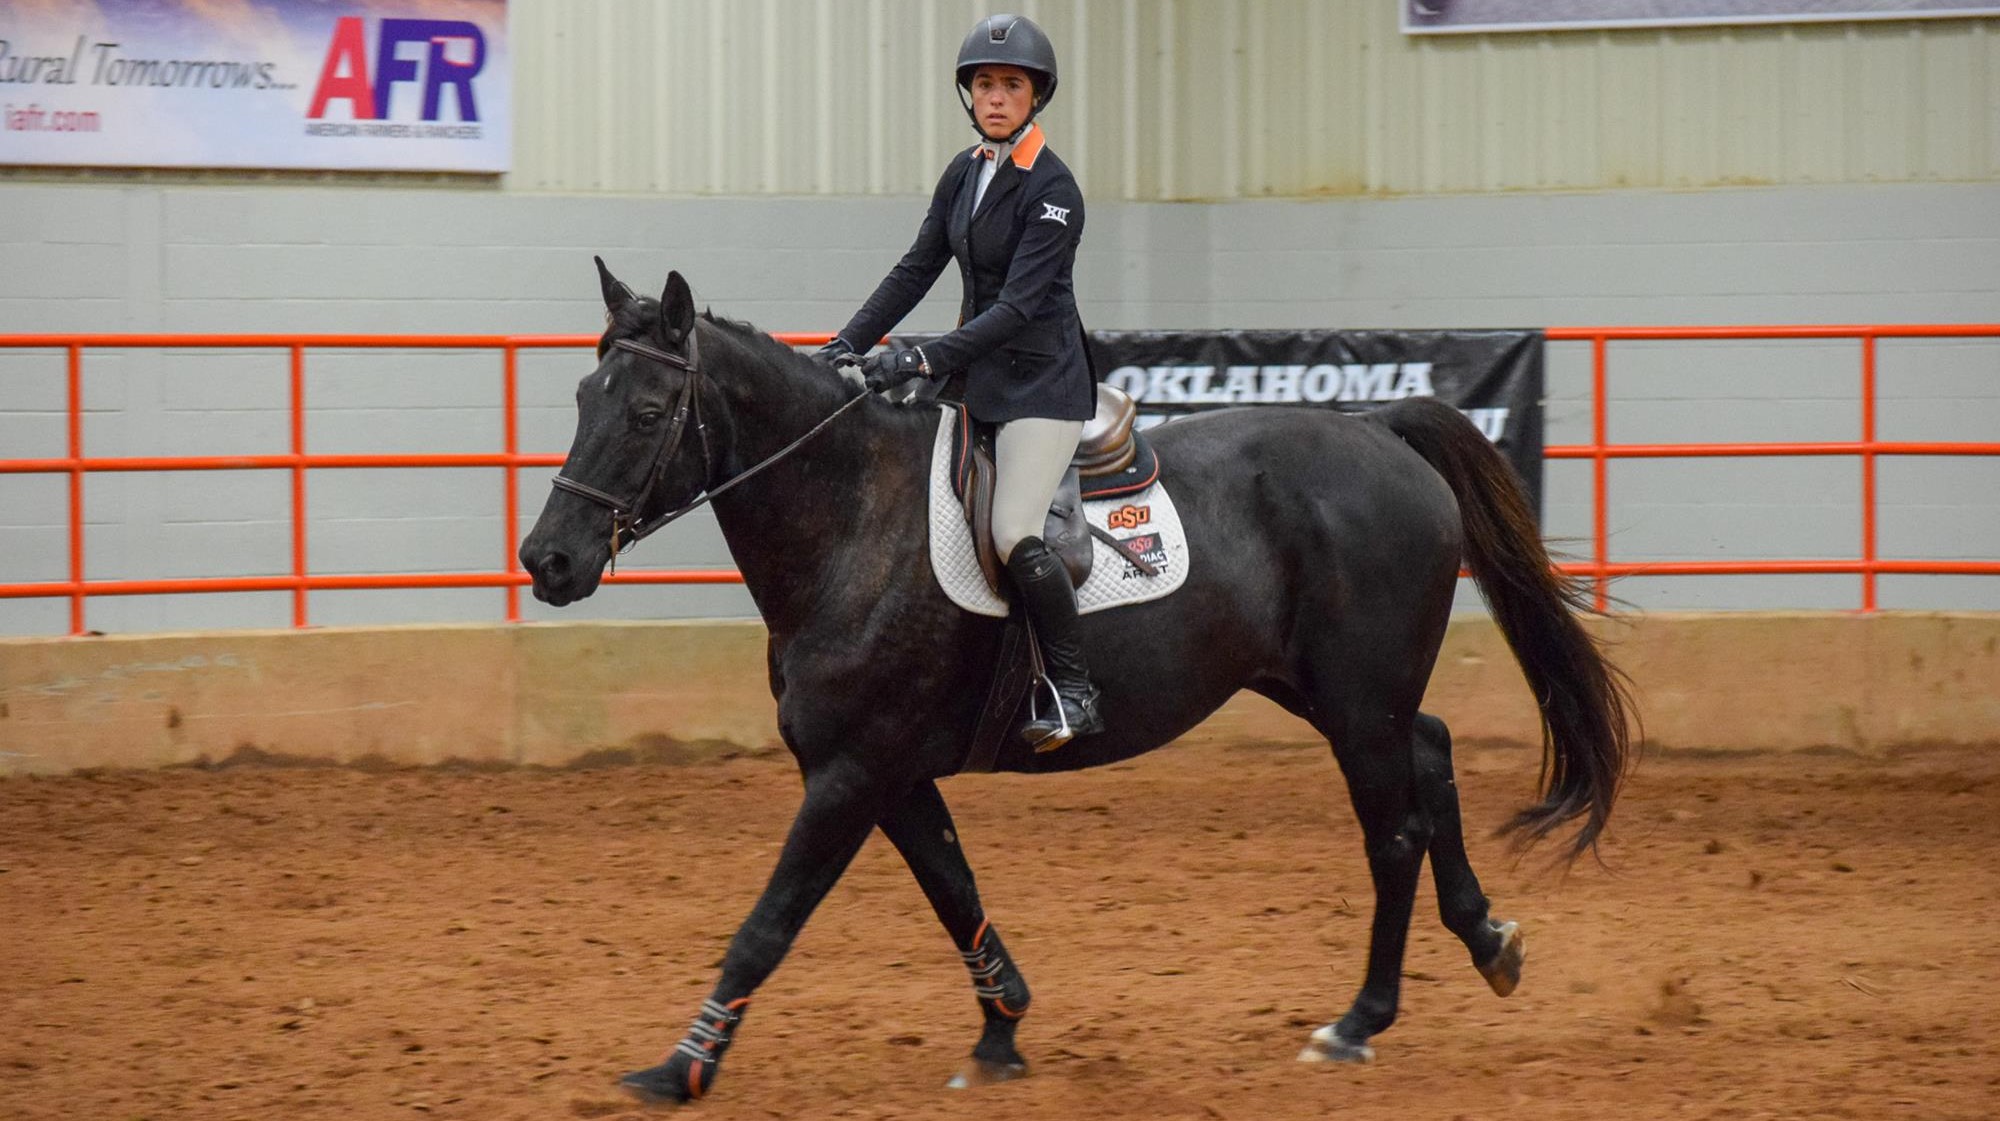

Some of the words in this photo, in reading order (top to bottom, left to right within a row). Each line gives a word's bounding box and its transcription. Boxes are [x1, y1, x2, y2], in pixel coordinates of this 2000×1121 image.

[92, 42, 298, 90] Tomorrows...
[306, 16, 486, 121] AFR
[6, 104, 100, 131] iafr.com
[1104, 362, 1434, 403] OKLAHOMA
[1108, 505, 1151, 530] OSU
[1122, 565, 1168, 580] ART
